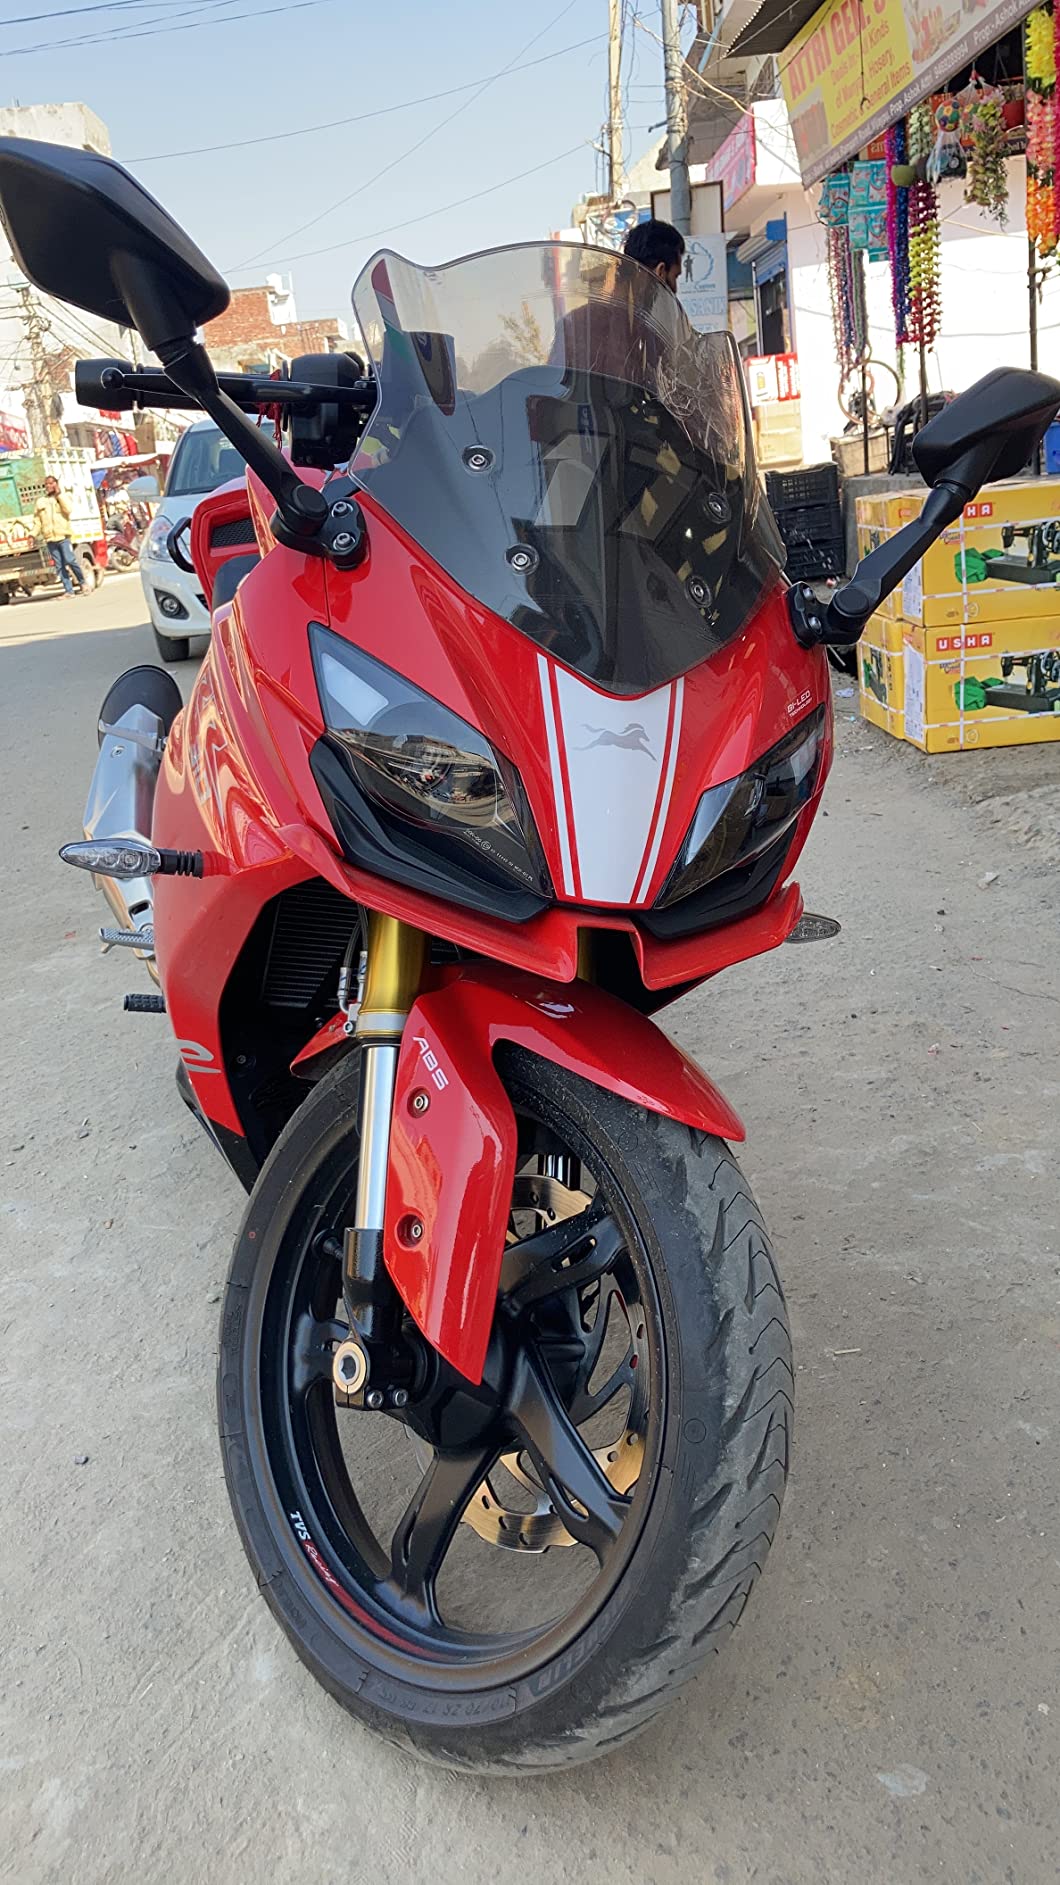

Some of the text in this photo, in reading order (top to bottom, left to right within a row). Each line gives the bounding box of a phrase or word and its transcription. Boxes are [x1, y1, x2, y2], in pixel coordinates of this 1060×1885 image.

[787, 24, 832, 101] ATTRI
[938, 634, 991, 650] USHA
[412, 1036, 449, 1091] ABS
[290, 1510, 312, 1541] TVS
